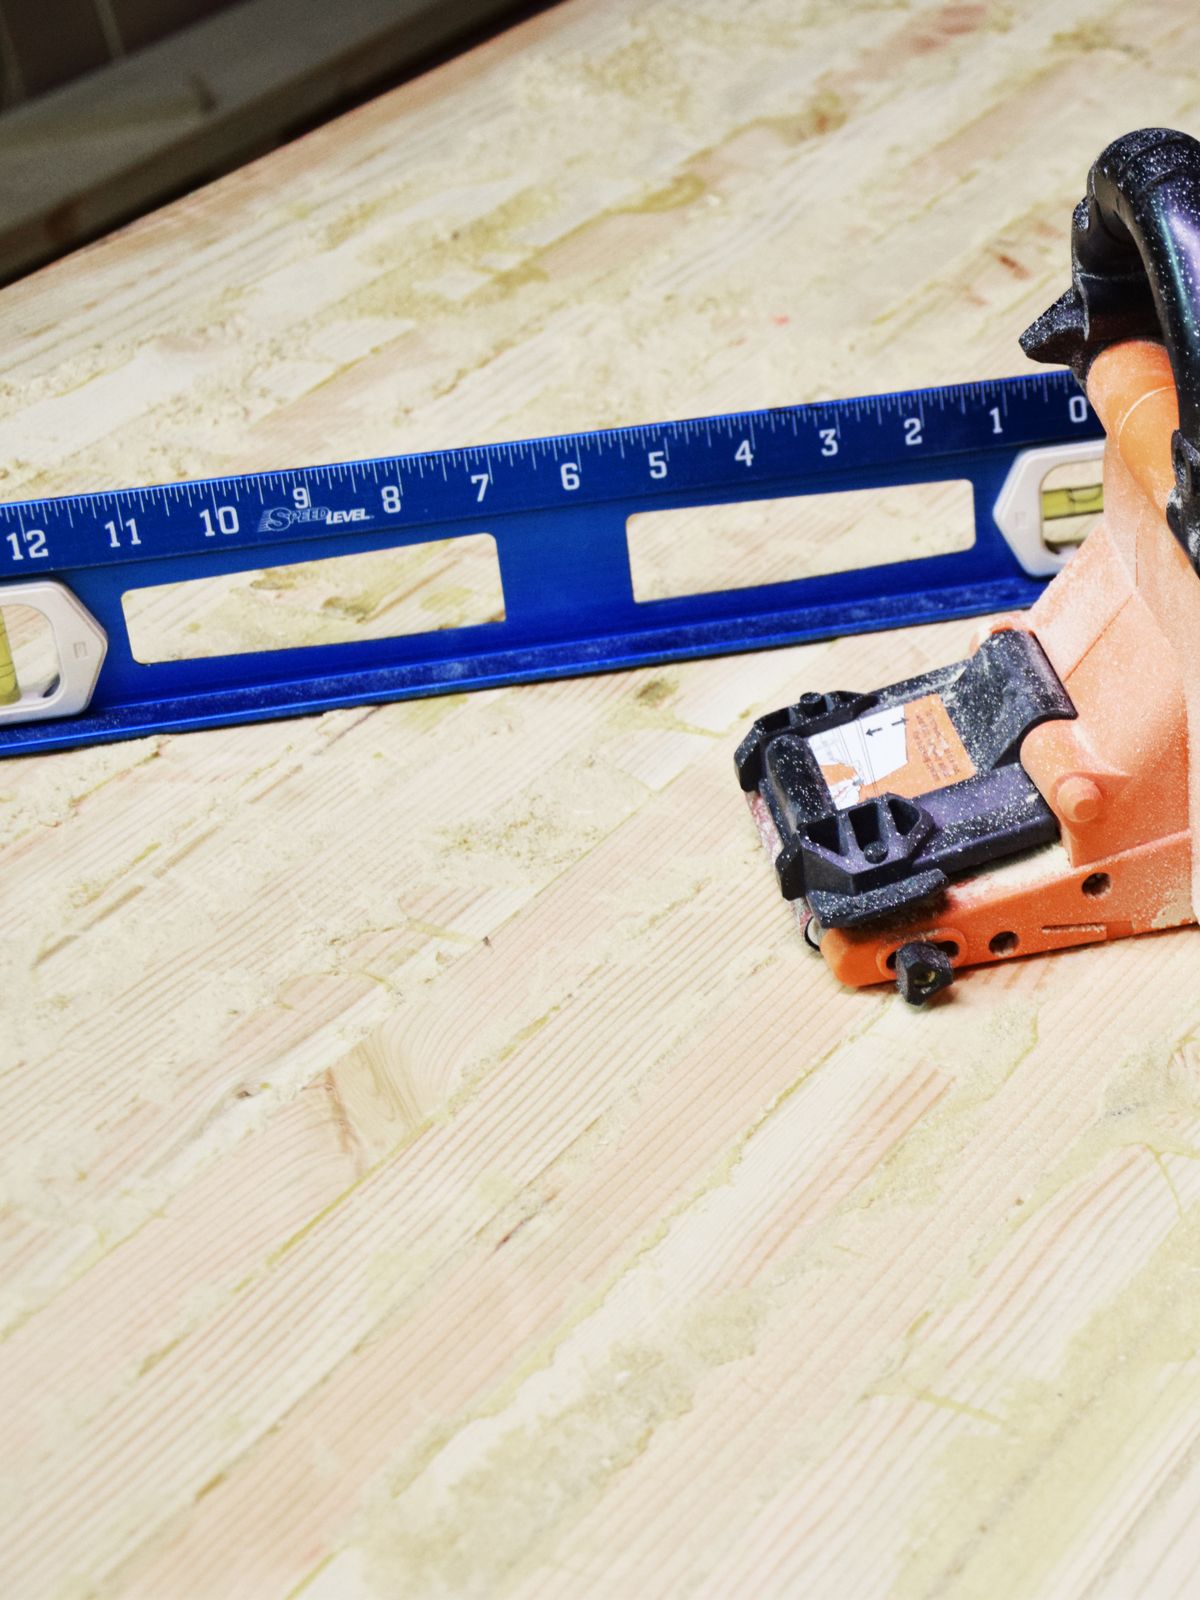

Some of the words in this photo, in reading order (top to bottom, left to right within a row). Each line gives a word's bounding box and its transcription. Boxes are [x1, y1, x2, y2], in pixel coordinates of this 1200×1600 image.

[6, 530, 49, 560] 12
[105, 518, 142, 548] 11
[200, 505, 239, 537] 10
[293, 487, 309, 509] 9
[381, 485, 401, 514] 8
[470, 474, 489, 502] 7
[560, 462, 581, 491] 6
[650, 451, 667, 479] 5
[735, 440, 754, 467] 4
[820, 429, 839, 457] 3
[904, 418, 923, 446] 2
[989, 408, 1003, 434] 1
[1069, 396, 1087, 423] 0
